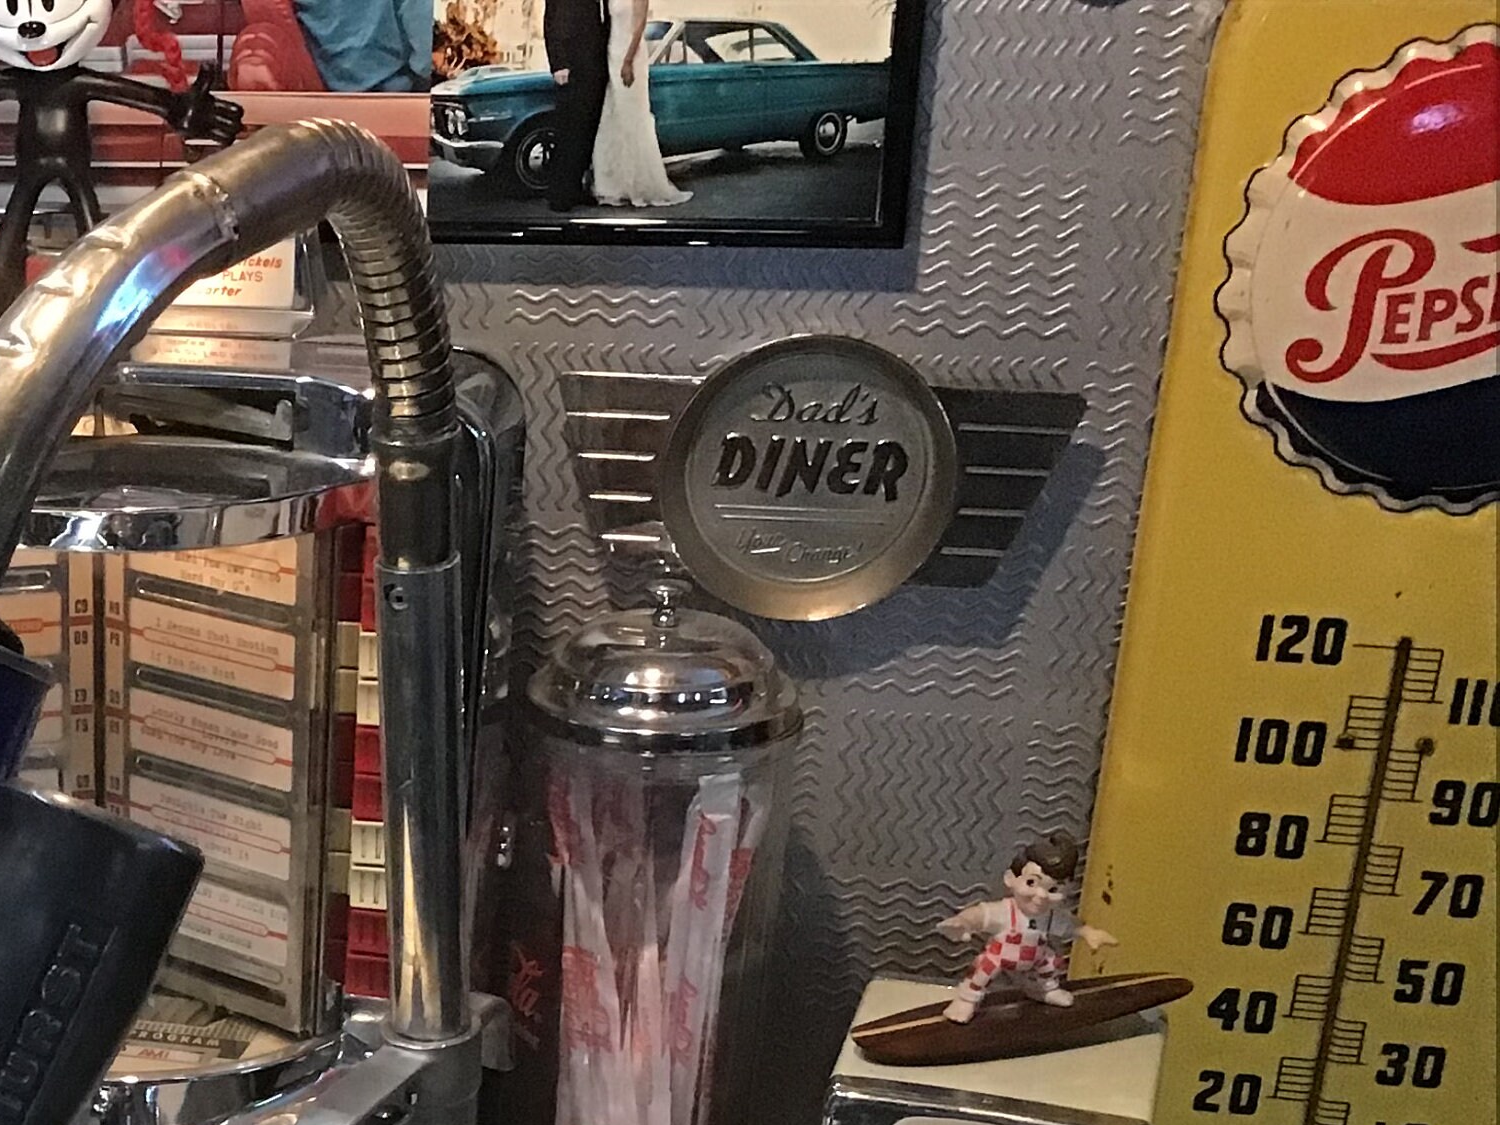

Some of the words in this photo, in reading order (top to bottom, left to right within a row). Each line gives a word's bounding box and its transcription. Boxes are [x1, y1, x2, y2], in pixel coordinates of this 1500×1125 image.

[222, 270, 264, 283] PLAYS
[237, 255, 284, 270] ickels
[750, 381, 881, 426] Dad's
[710, 431, 910, 502] DINER
[1255, 614, 1349, 667] 120
[1234, 716, 1328, 768] 100
[1429, 779, 1500, 828] 90
[1235, 811, 1310, 860] 80
[1412, 870, 1485, 919] 70
[1221, 902, 1295, 951] 60
[1393, 958, 1466, 1007] 50
[1206, 987, 1278, 1035] 40
[138, 1047, 171, 1060] AMI
[1375, 1042, 1447, 1089] 30
[1192, 1069, 1263, 1116] 20
